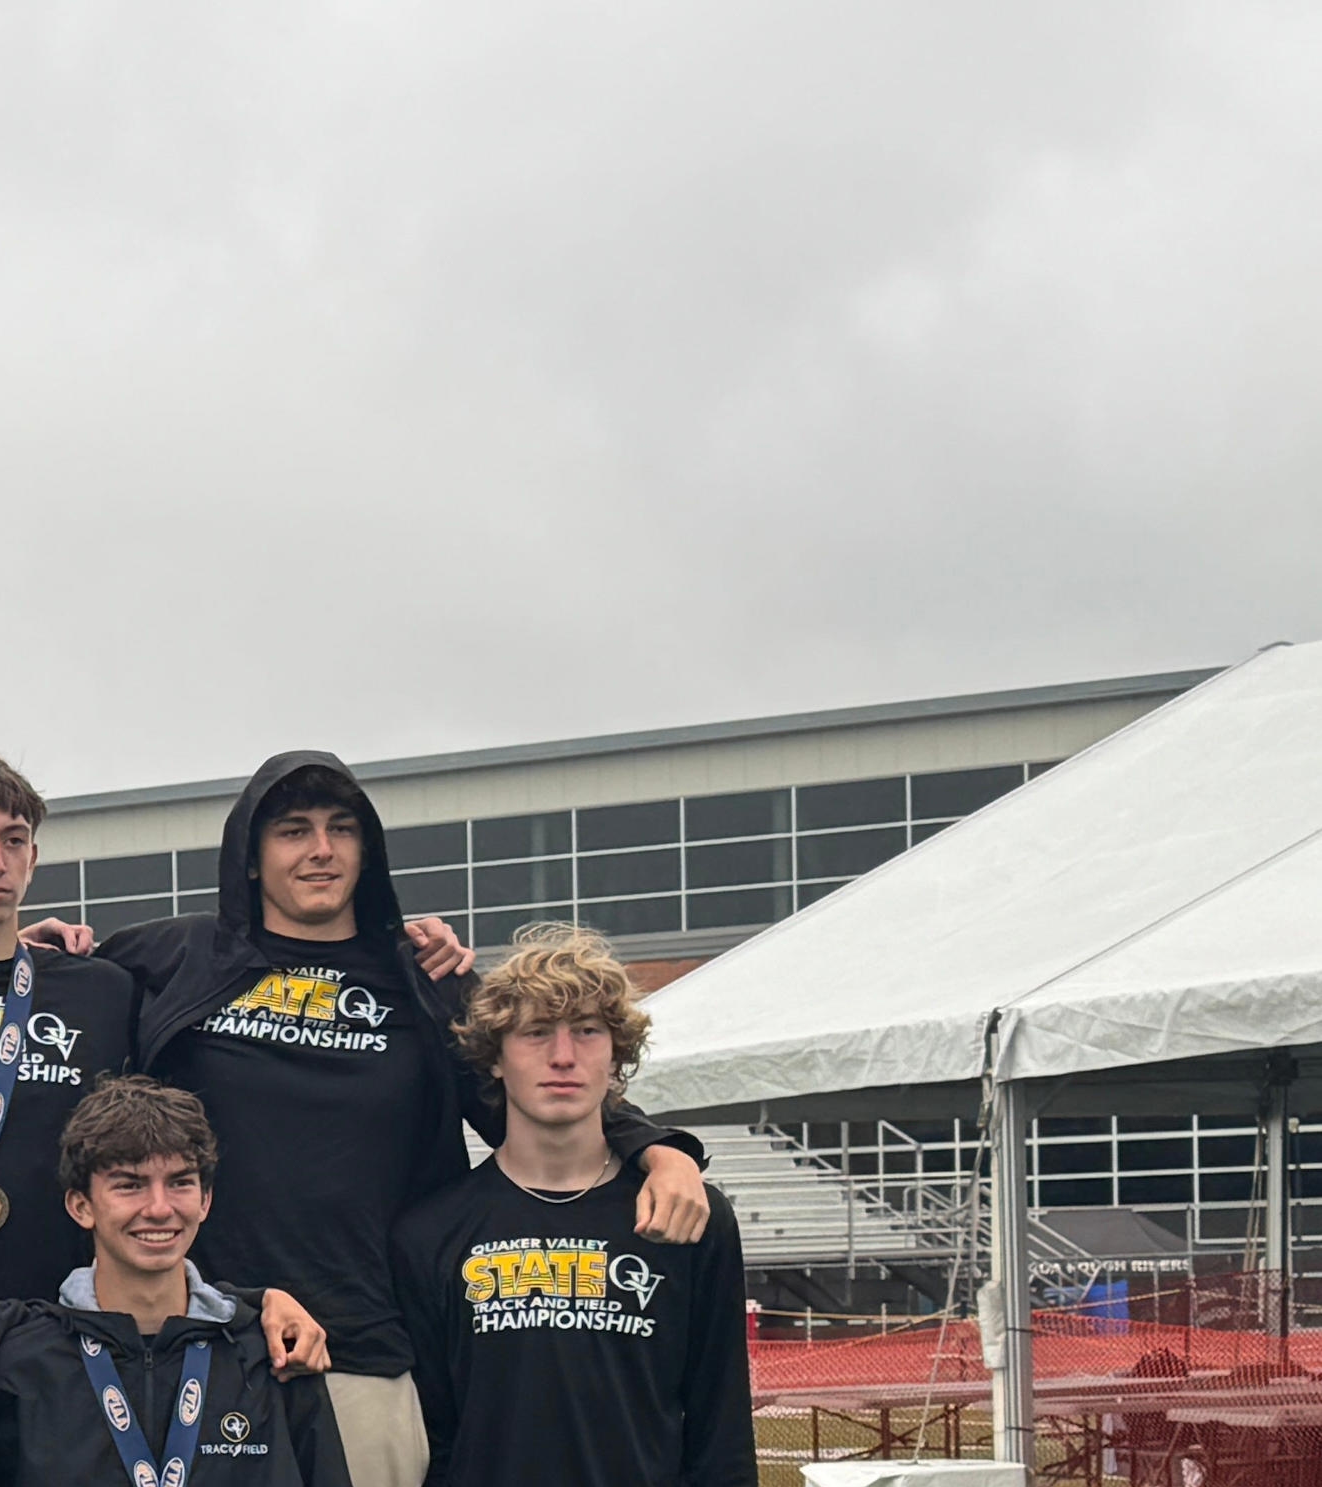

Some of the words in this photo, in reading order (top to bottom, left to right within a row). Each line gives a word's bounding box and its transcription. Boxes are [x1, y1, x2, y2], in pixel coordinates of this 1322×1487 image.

[230, 973, 342, 1022] ATE
[256, 1009, 297, 1025] AND
[193, 1014, 389, 1053] HAMPIONSHIPS
[470, 1237, 541, 1256] QUAKER
[545, 1237, 609, 1251] VALLEY
[462, 1250, 608, 1303] STATE
[609, 1254, 666, 1311] QV
[472, 1298, 527, 1315] TRACK
[529, 1296, 570, 1310] AND
[575, 1298, 623, 1313] FIELD
[472, 1308, 657, 1338] CHAMPIONSHIPS
[200, 1443, 234, 1455] TRACK
[242, 1444, 269, 1455] FIELD
